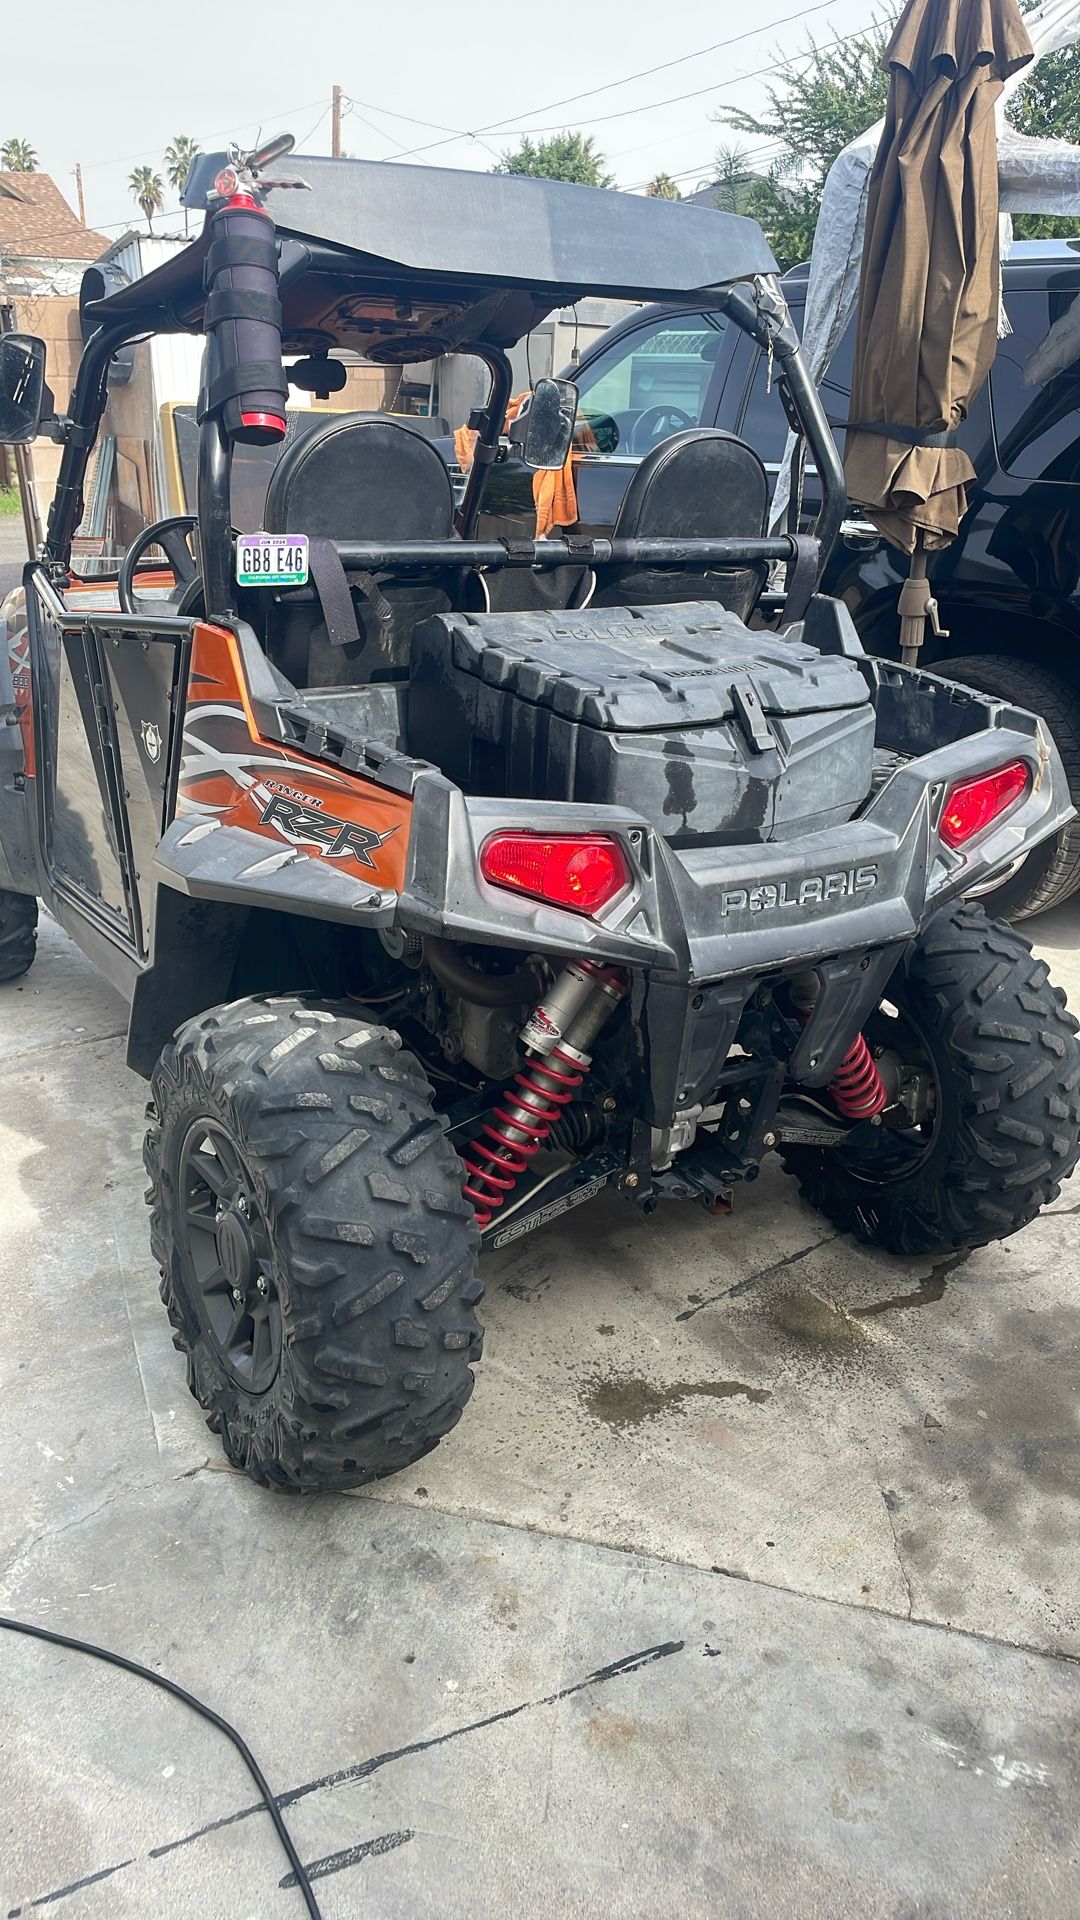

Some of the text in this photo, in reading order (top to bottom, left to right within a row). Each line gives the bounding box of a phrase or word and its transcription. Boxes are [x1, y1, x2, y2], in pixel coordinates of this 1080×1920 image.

[243, 548, 303, 573] GB8 E46
[548, 623, 675, 641] POLARIS
[264, 778, 324, 808] RANGER
[259, 794, 382, 870] RZR
[720, 863, 879, 918] POLARIS
